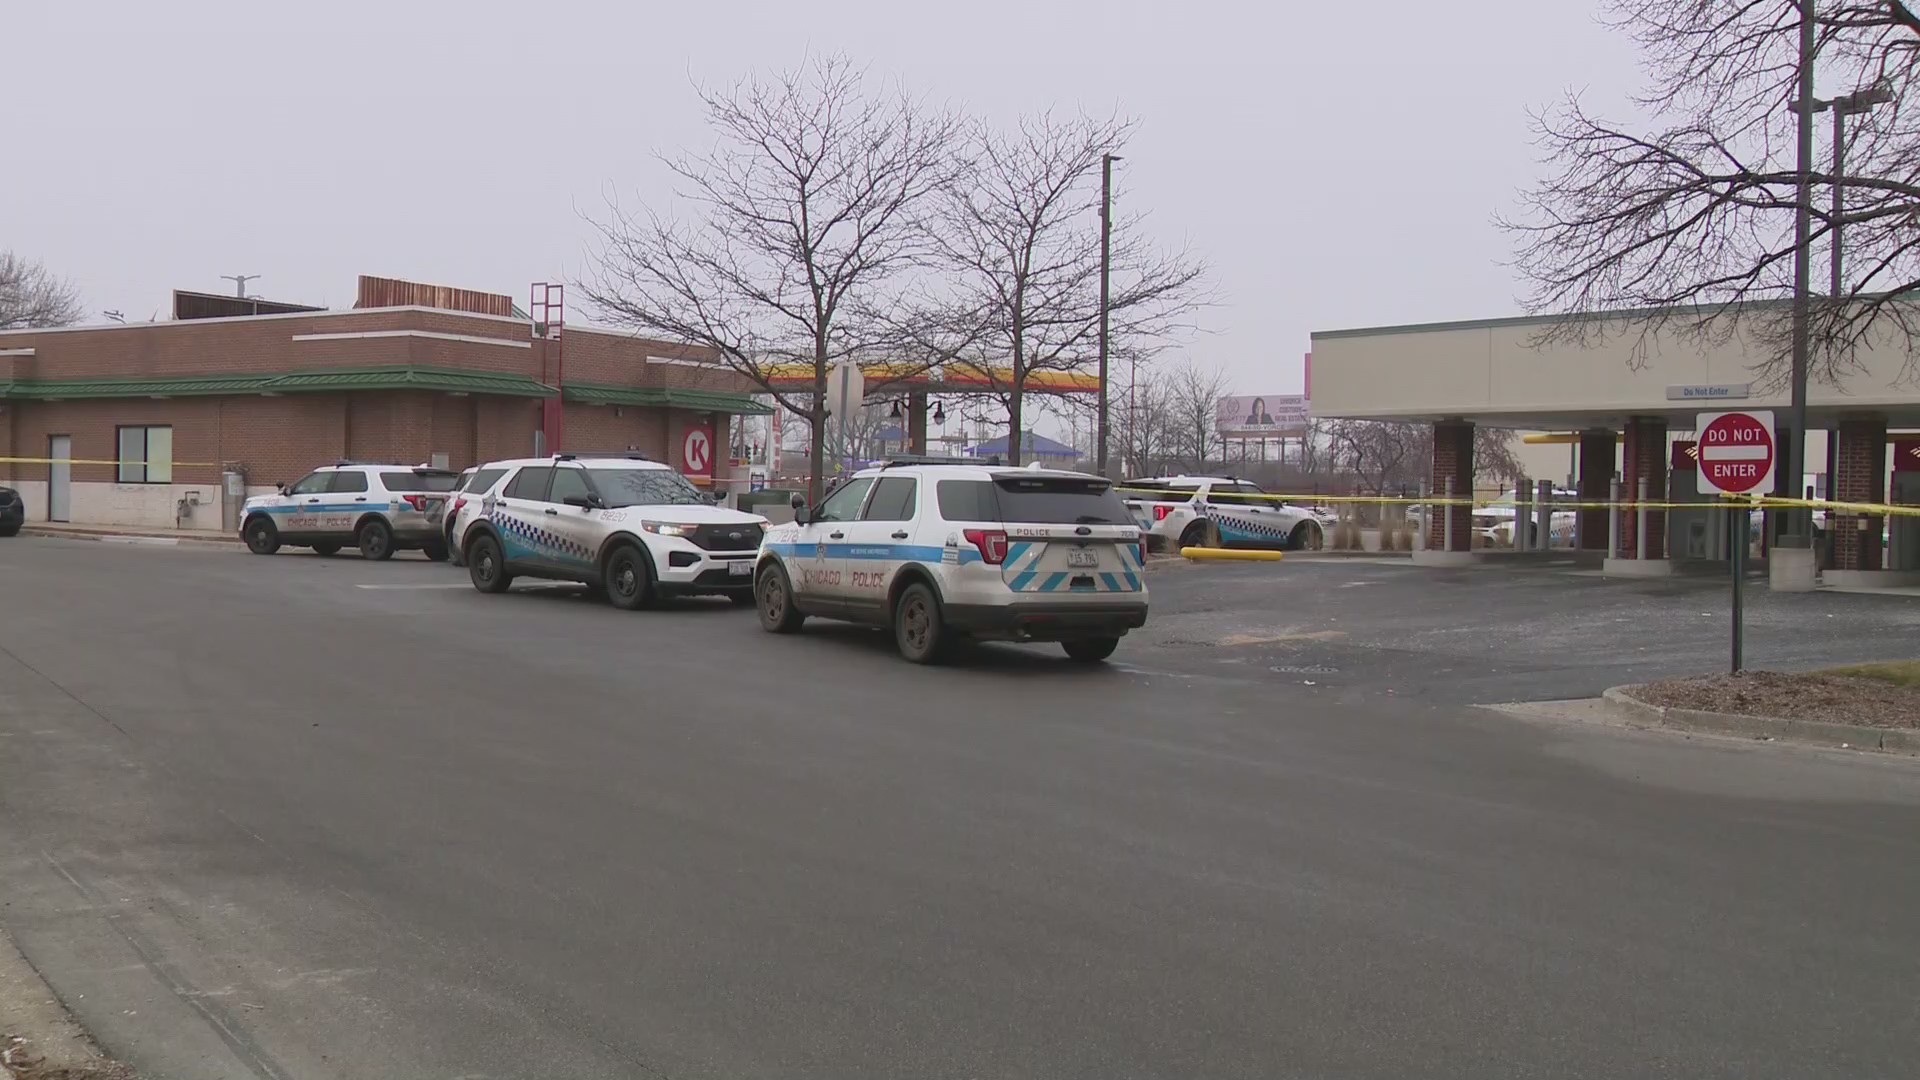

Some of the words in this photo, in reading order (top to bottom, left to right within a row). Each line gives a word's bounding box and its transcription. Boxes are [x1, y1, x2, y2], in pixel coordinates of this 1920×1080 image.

[1684, 388, 1693, 396] Do
[1695, 387, 1707, 396] Not
[1709, 387, 1728, 395] Enter
[1709, 429, 1727, 442] DO
[1733, 428, 1761, 441] NOT
[1714, 464, 1756, 477] ENTER
[288, 518, 317, 526] CHICAGO
[326, 518, 351, 526] POLICE
[1016, 528, 1050, 536] POLICE
[804, 570, 841, 585] CHICAGO
[852, 571, 885, 588] POLICE
